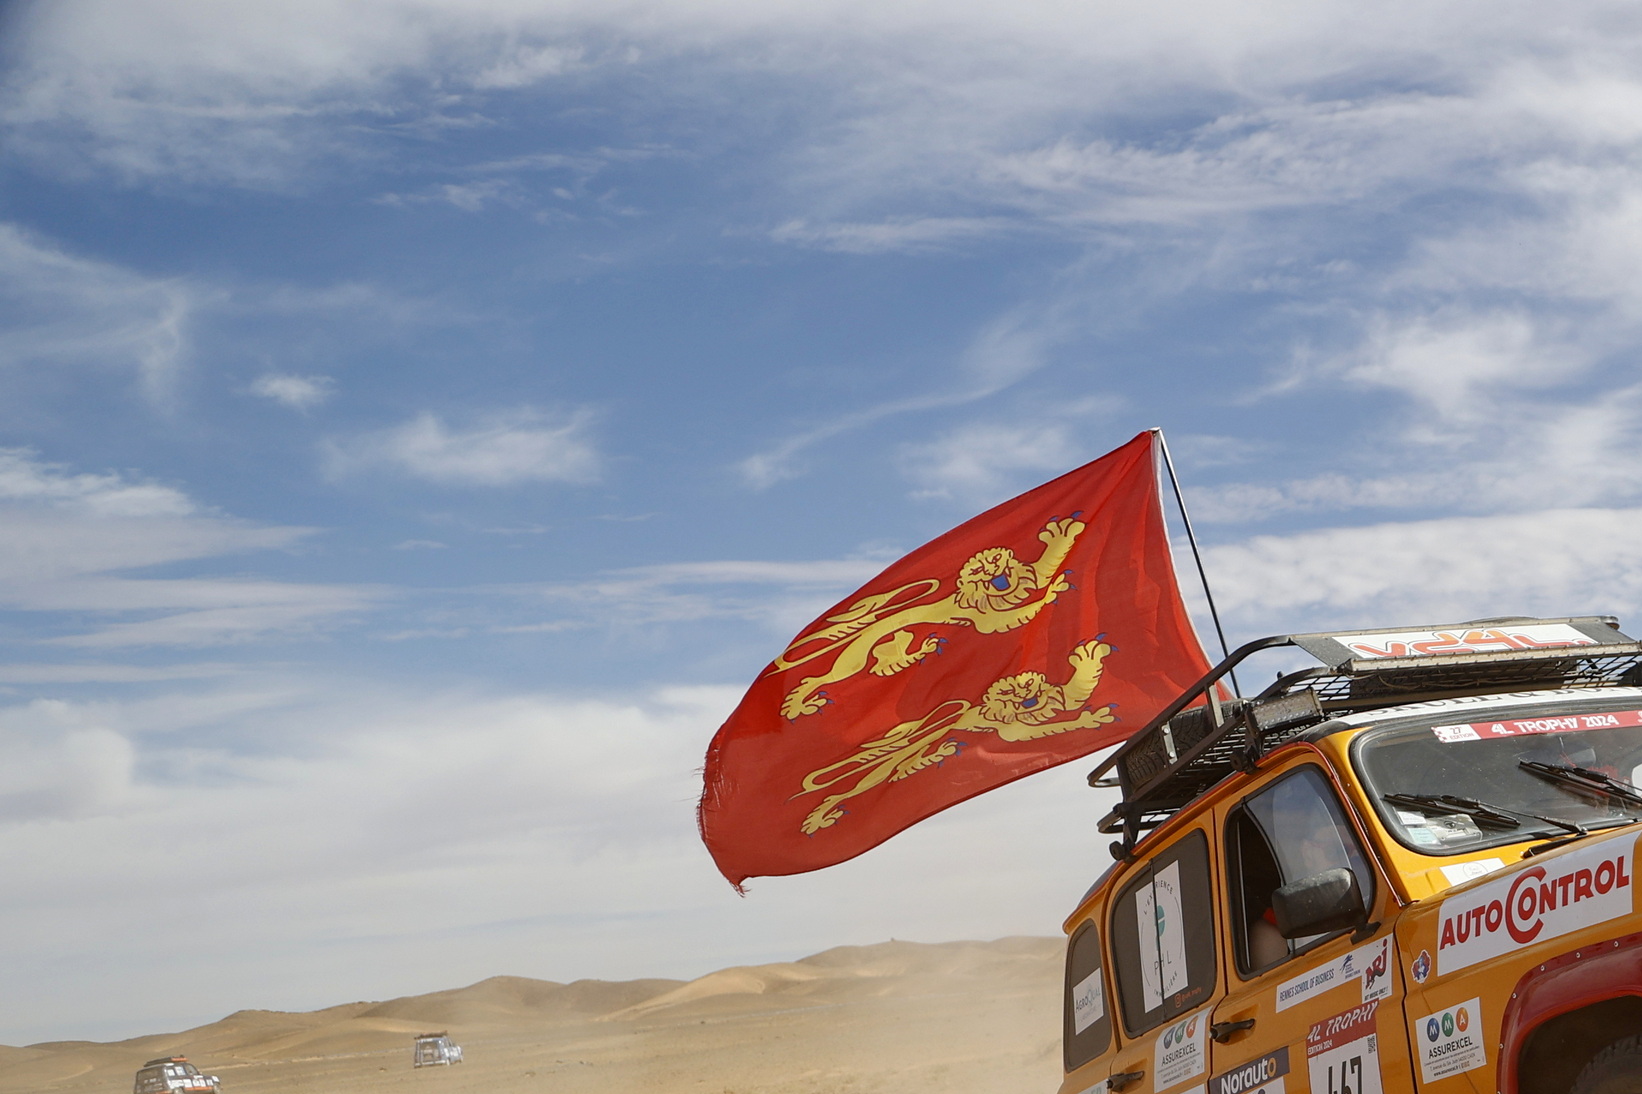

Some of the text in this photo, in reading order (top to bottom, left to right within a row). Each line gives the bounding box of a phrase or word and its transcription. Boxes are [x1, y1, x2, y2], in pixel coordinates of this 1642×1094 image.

[1491, 715, 1620, 735] 4L TROPHY 2024
[1294, 980, 1309, 995] SCHOOL
[1309, 977, 1315, 988] OF
[1314, 968, 1334, 986] BUSINESS
[1325, 1001, 1379, 1036] TROPHY
[1161, 1042, 1196, 1066] ASSUREXCEL
[1428, 1036, 1473, 1060] ASSUREXCEL
